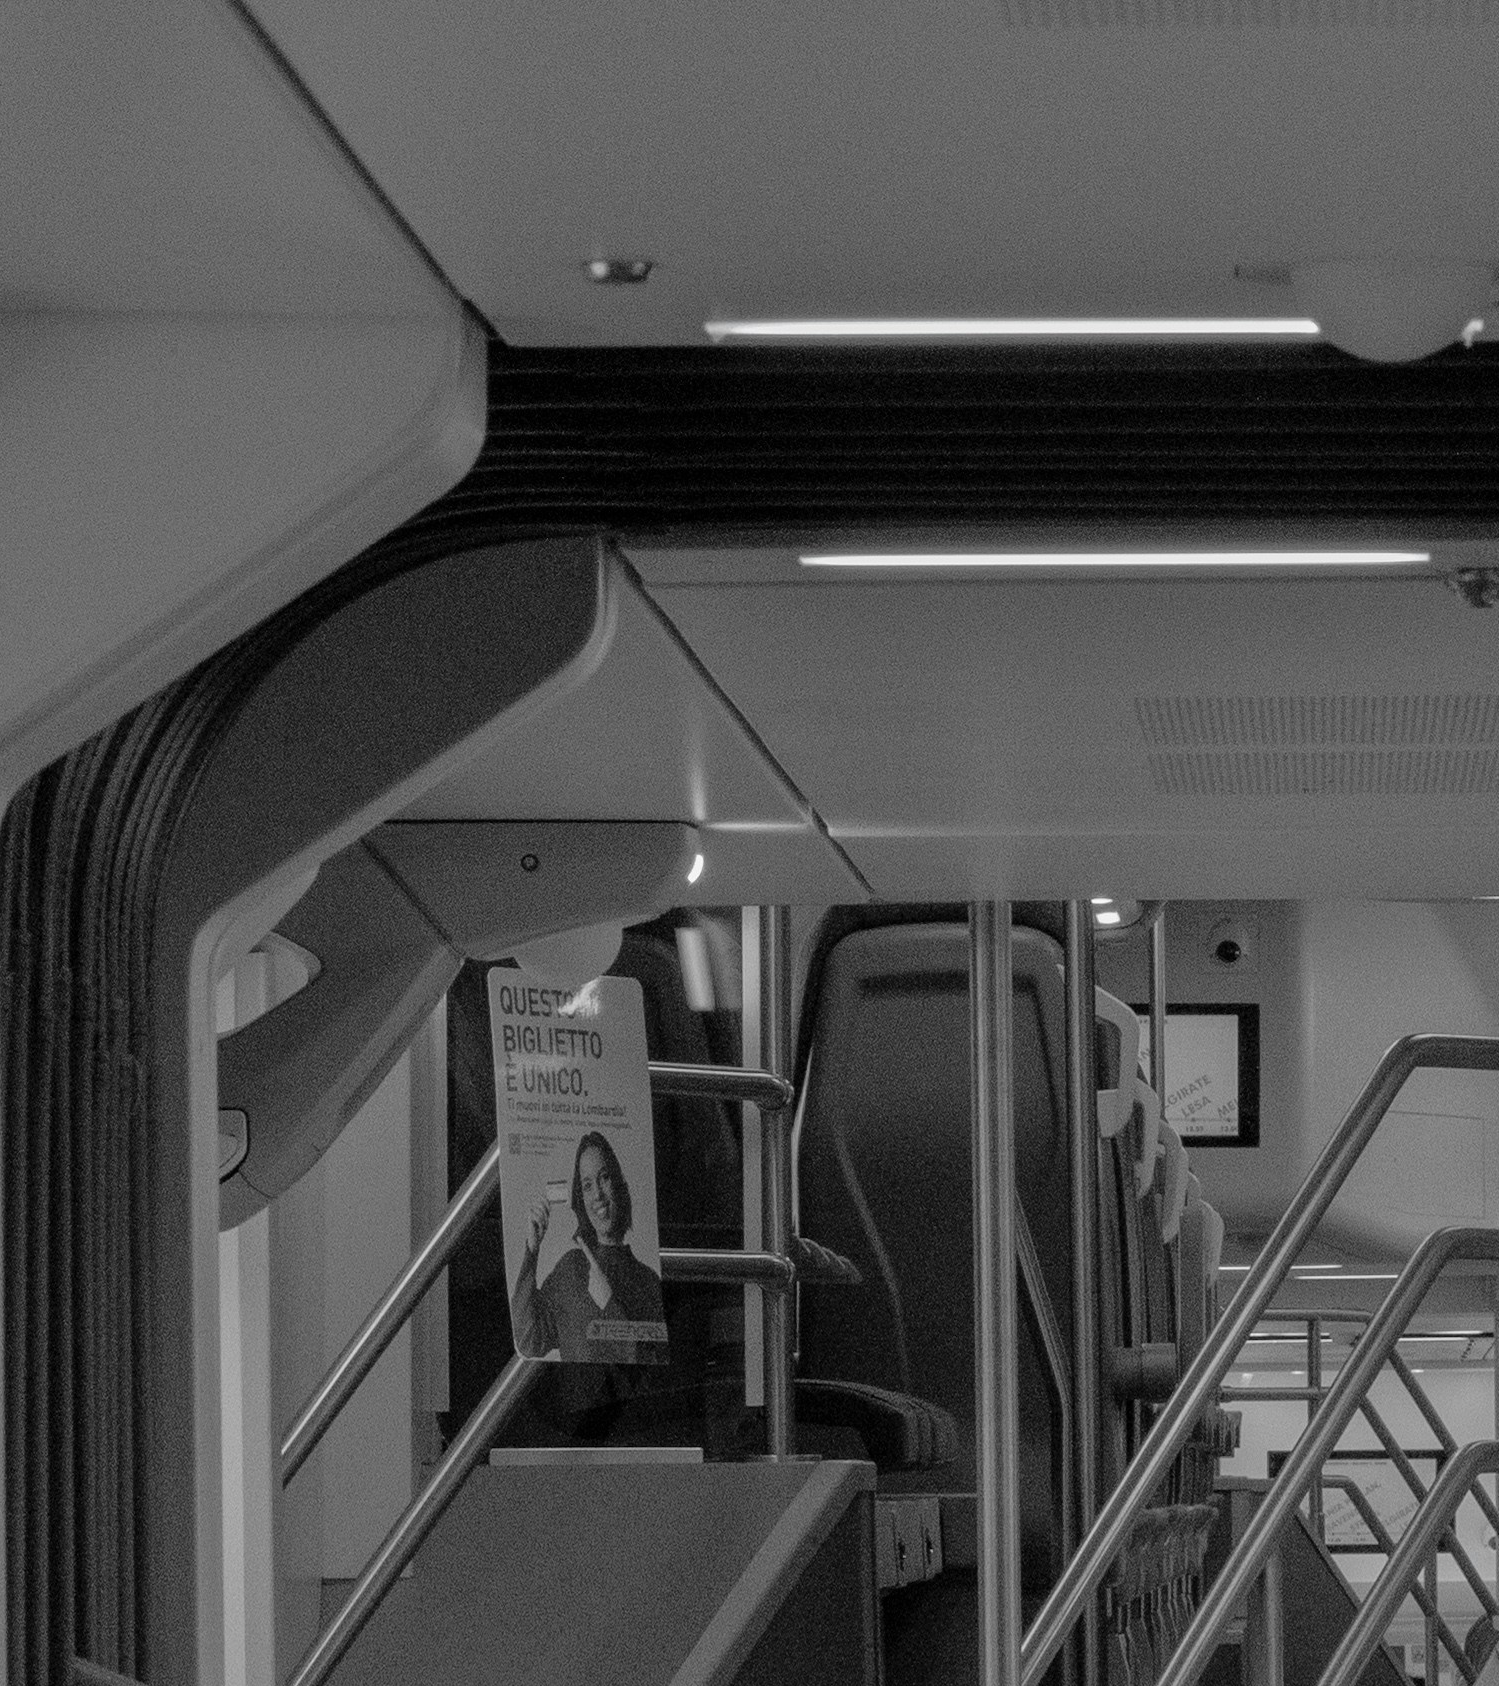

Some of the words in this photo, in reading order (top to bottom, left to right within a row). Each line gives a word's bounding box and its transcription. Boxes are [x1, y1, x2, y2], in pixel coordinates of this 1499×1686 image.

[503, 1025, 603, 1059] BIGLIETTO
[523, 1064, 588, 1097] UNICO.
[1181, 1095, 1212, 1118] LESA
